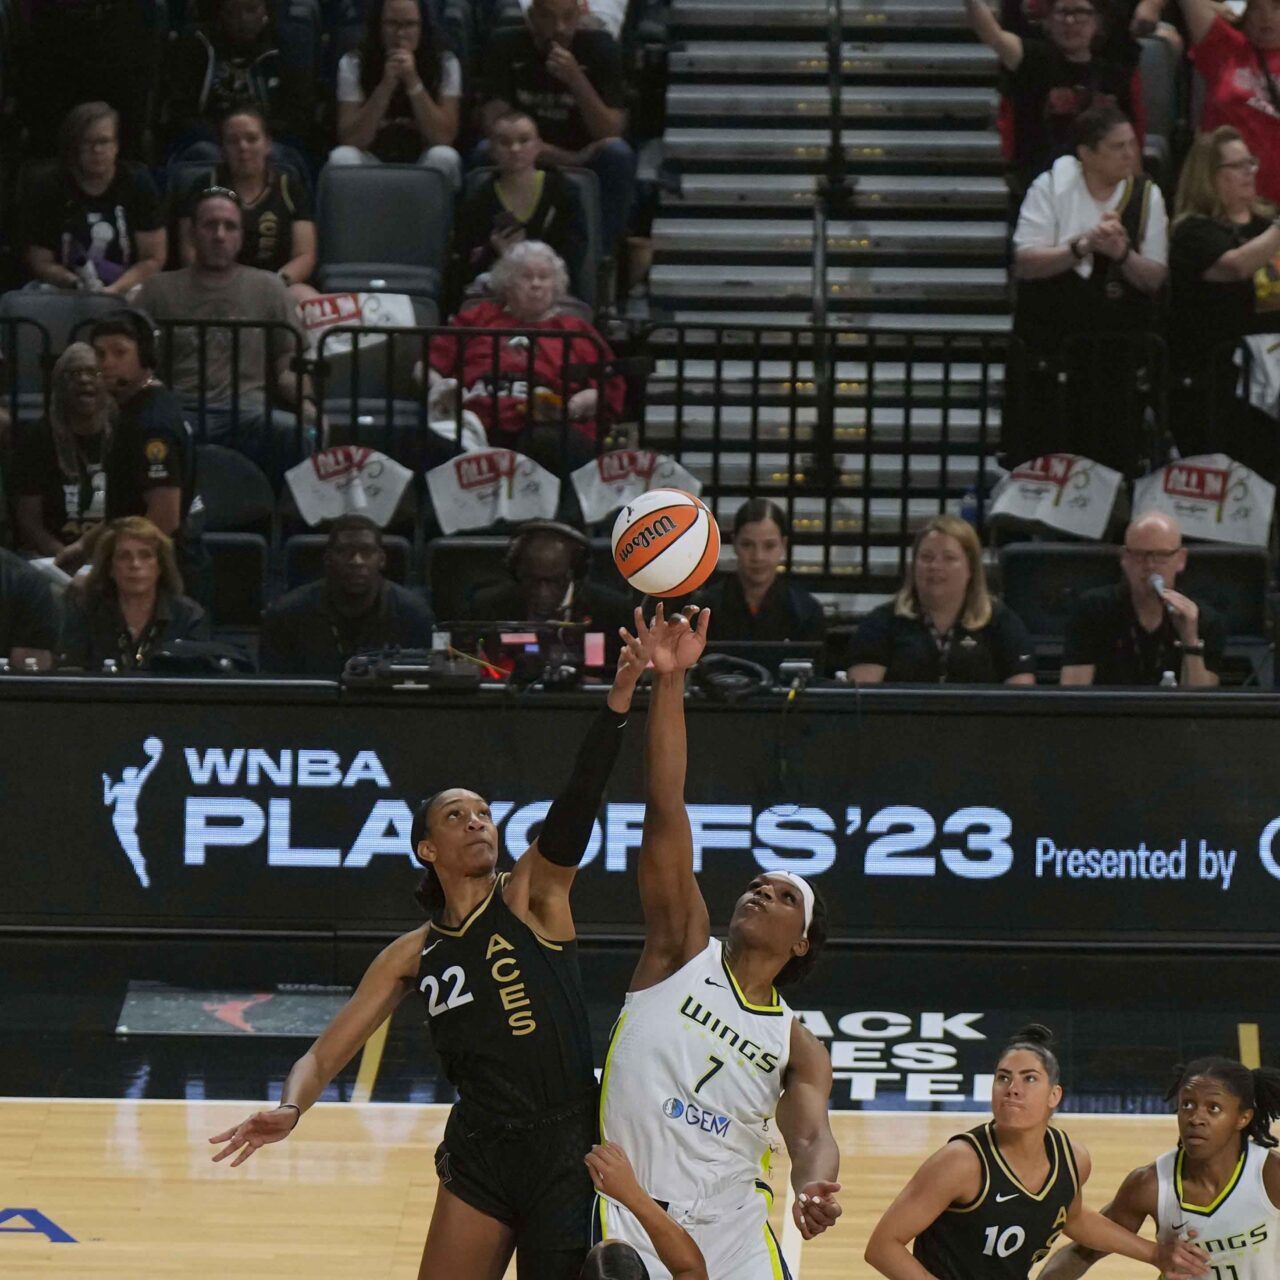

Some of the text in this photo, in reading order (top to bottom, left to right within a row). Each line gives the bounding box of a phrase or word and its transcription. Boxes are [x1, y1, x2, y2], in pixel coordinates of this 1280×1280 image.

[1166, 466, 1202, 497] ALL
[620, 512, 680, 564] Wilson
[184, 748, 391, 787] WNBA
[1035, 837, 1187, 880] Presented
[1199, 839, 1238, 891] by
[420, 965, 475, 1018] 22
[485, 932, 537, 1037] ACES
[678, 995, 780, 1075] WINGS
[694, 1056, 725, 1095] 7
[685, 1103, 732, 1139] GEM
[981, 1225, 1026, 1260] 10
